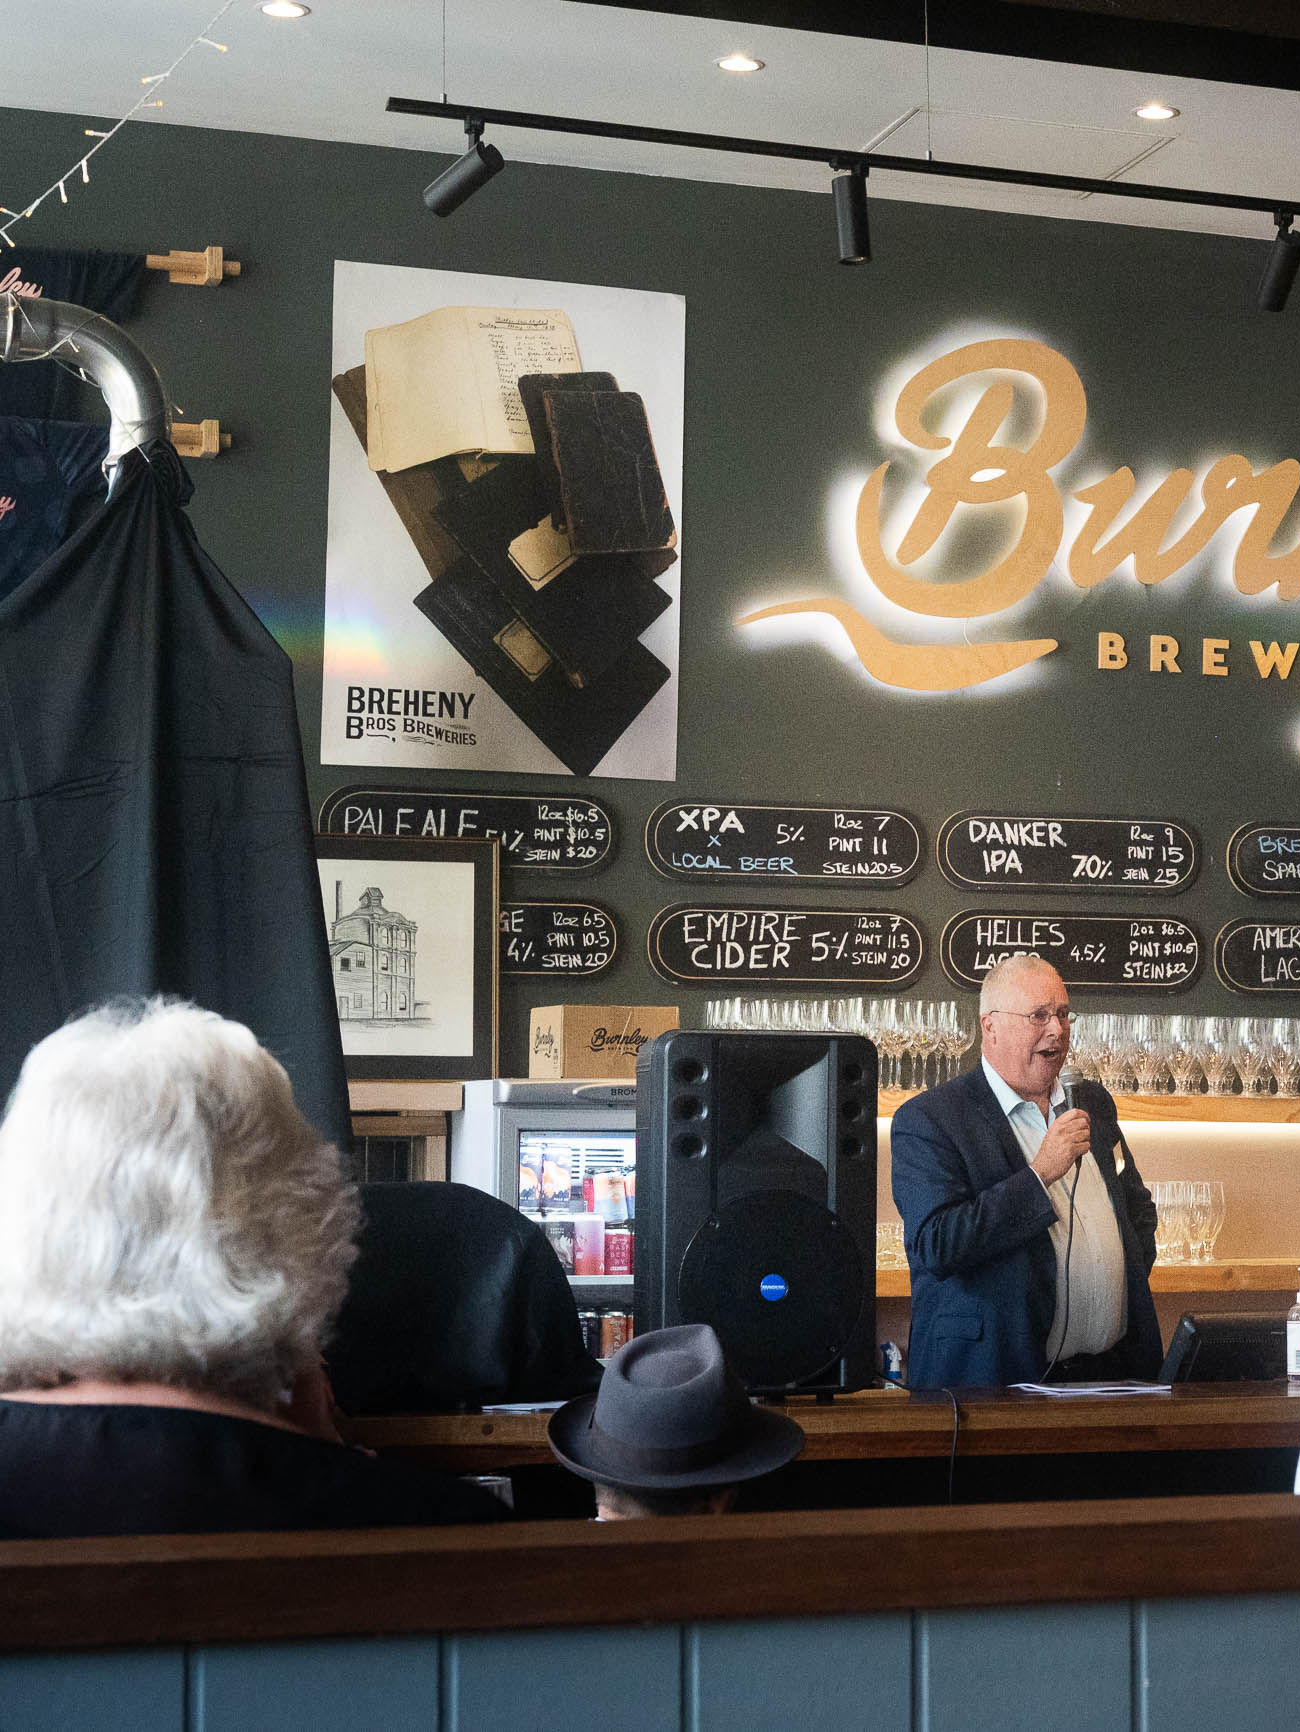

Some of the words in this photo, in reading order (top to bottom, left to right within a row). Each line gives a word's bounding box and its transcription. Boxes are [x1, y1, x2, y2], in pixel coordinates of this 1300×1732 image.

[347, 686, 476, 720] BREHENY
[403, 718, 477, 746] BREWERIES
[566, 807, 599, 823] $6.5
[676, 807, 745, 833] XPA
[834, 813, 864, 830] 12oz
[873, 816, 891, 832] 7
[534, 828, 564, 841] PINT
[567, 828, 606, 844] $10.5
[776, 823, 805, 844] 5%
[968, 820, 1067, 848] DANKER
[1164, 827, 1174, 846] 9
[524, 848, 560, 861] STEIN
[566, 846, 597, 859] $20
[828, 837, 863, 852] PINT
[873, 836, 888, 855] 11
[1127, 846, 1154, 860] PINT
[1161, 846, 1185, 863] 15
[673, 852, 732, 869] LOCAL
[739, 856, 798, 875] BEER
[983, 850, 1023, 875] IPA
[1071, 854, 1113, 879] 7.0%
[1121, 867, 1149, 881] STEIN
[1153, 868, 1180, 884] 25
[583, 912, 606, 927] 6.5
[683, 913, 806, 944] EMPIRE
[856, 917, 882, 929] 12oz
[890, 917, 902, 932] 7
[547, 932, 575, 947] PINT
[582, 931, 610, 947] 10.5
[976, 919, 1065, 947] HELLES
[1161, 923, 1186, 937] $6.5
[507, 938, 535, 962] 4%
[811, 931, 849, 961] 5%
[855, 934, 883, 946] PINT
[888, 933, 910, 949] 11.5
[1129, 942, 1161, 957] PINT
[1163, 942, 1198, 957] $10.5
[542, 953, 582, 968] STEIN
[585, 952, 607, 967] 20
[691, 942, 791, 970] CIDER
[851, 952, 887, 965] STEIN
[891, 952, 911, 969] 20
[1070, 943, 1106, 963] 4.5%
[1123, 962, 1164, 980] STEIN
